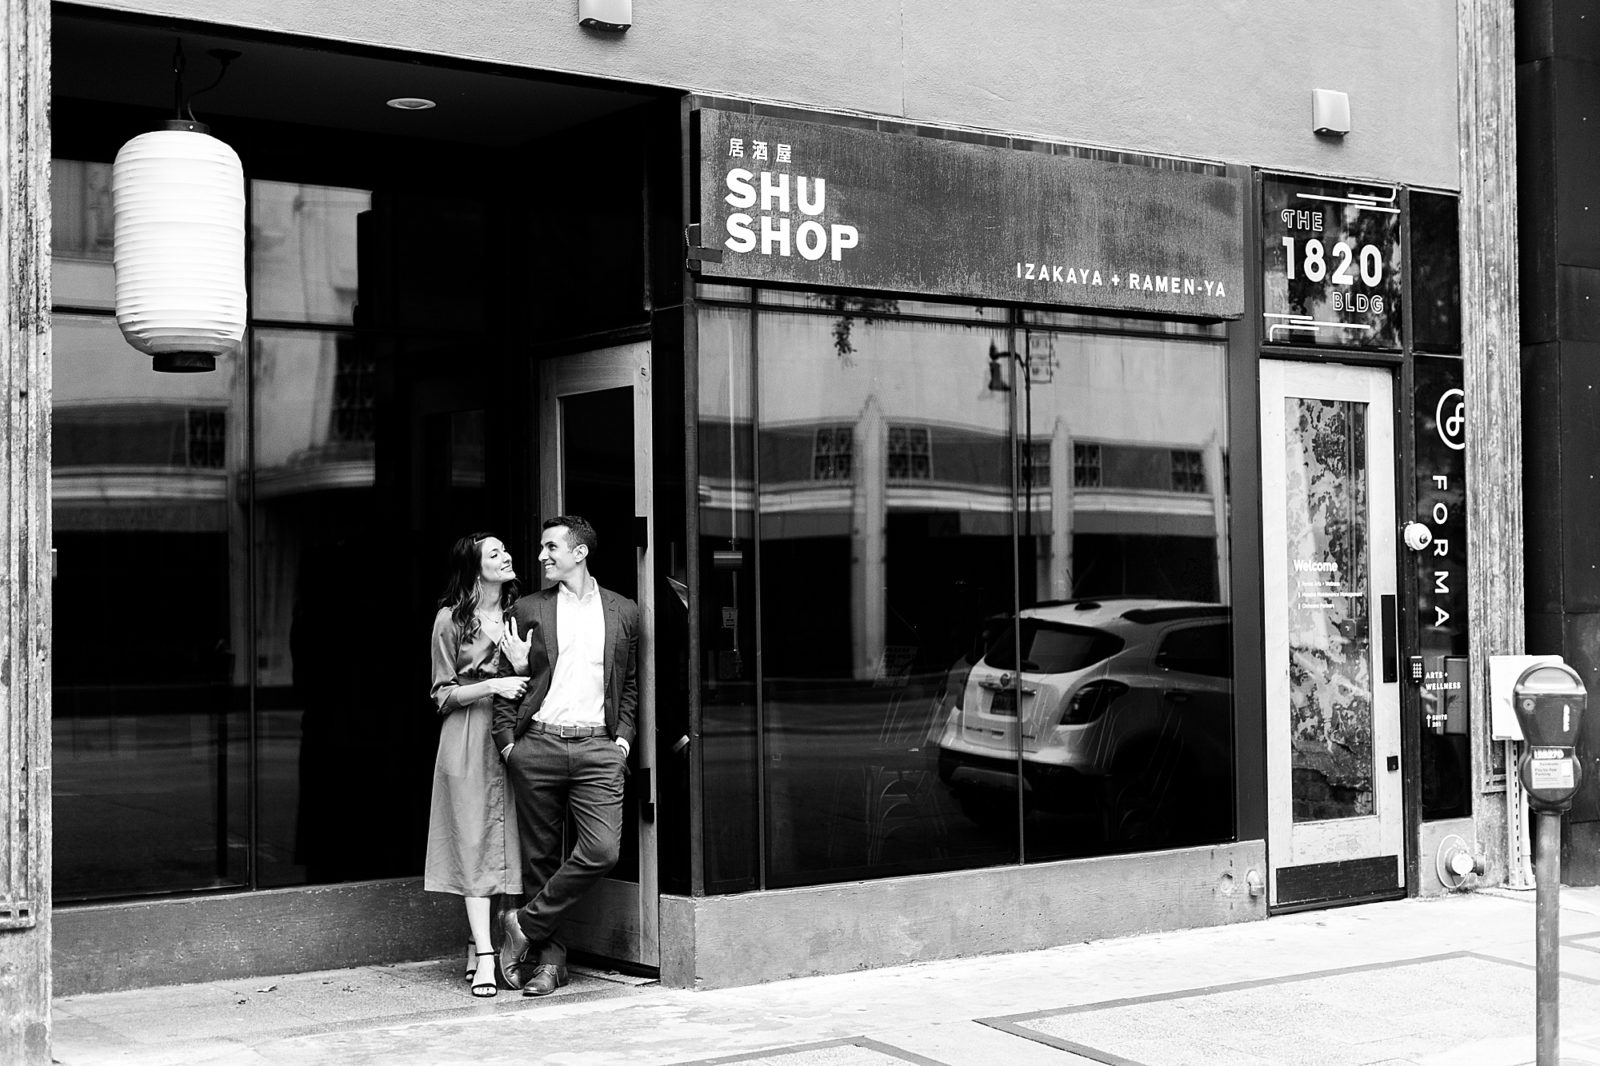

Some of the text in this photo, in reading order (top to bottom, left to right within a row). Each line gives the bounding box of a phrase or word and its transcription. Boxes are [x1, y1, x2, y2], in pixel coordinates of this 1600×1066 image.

[729, 138, 792, 164] 居酒屋
[725, 168, 826, 216] SHU
[1281, 208, 1323, 231] THE
[725, 213, 859, 261] SHOP
[1282, 236, 1382, 287] 1820
[1017, 262, 1103, 286] IZAKAYA
[1129, 274, 1226, 298] RAMEN-YA
[1332, 291, 1384, 314] BLDG
[1432, 475, 1449, 627] FORMA
[1293, 560, 1338, 571] Welcome
[1425, 671, 1443, 679] ARTS
[1425, 682, 1461, 691] WELLNESS
